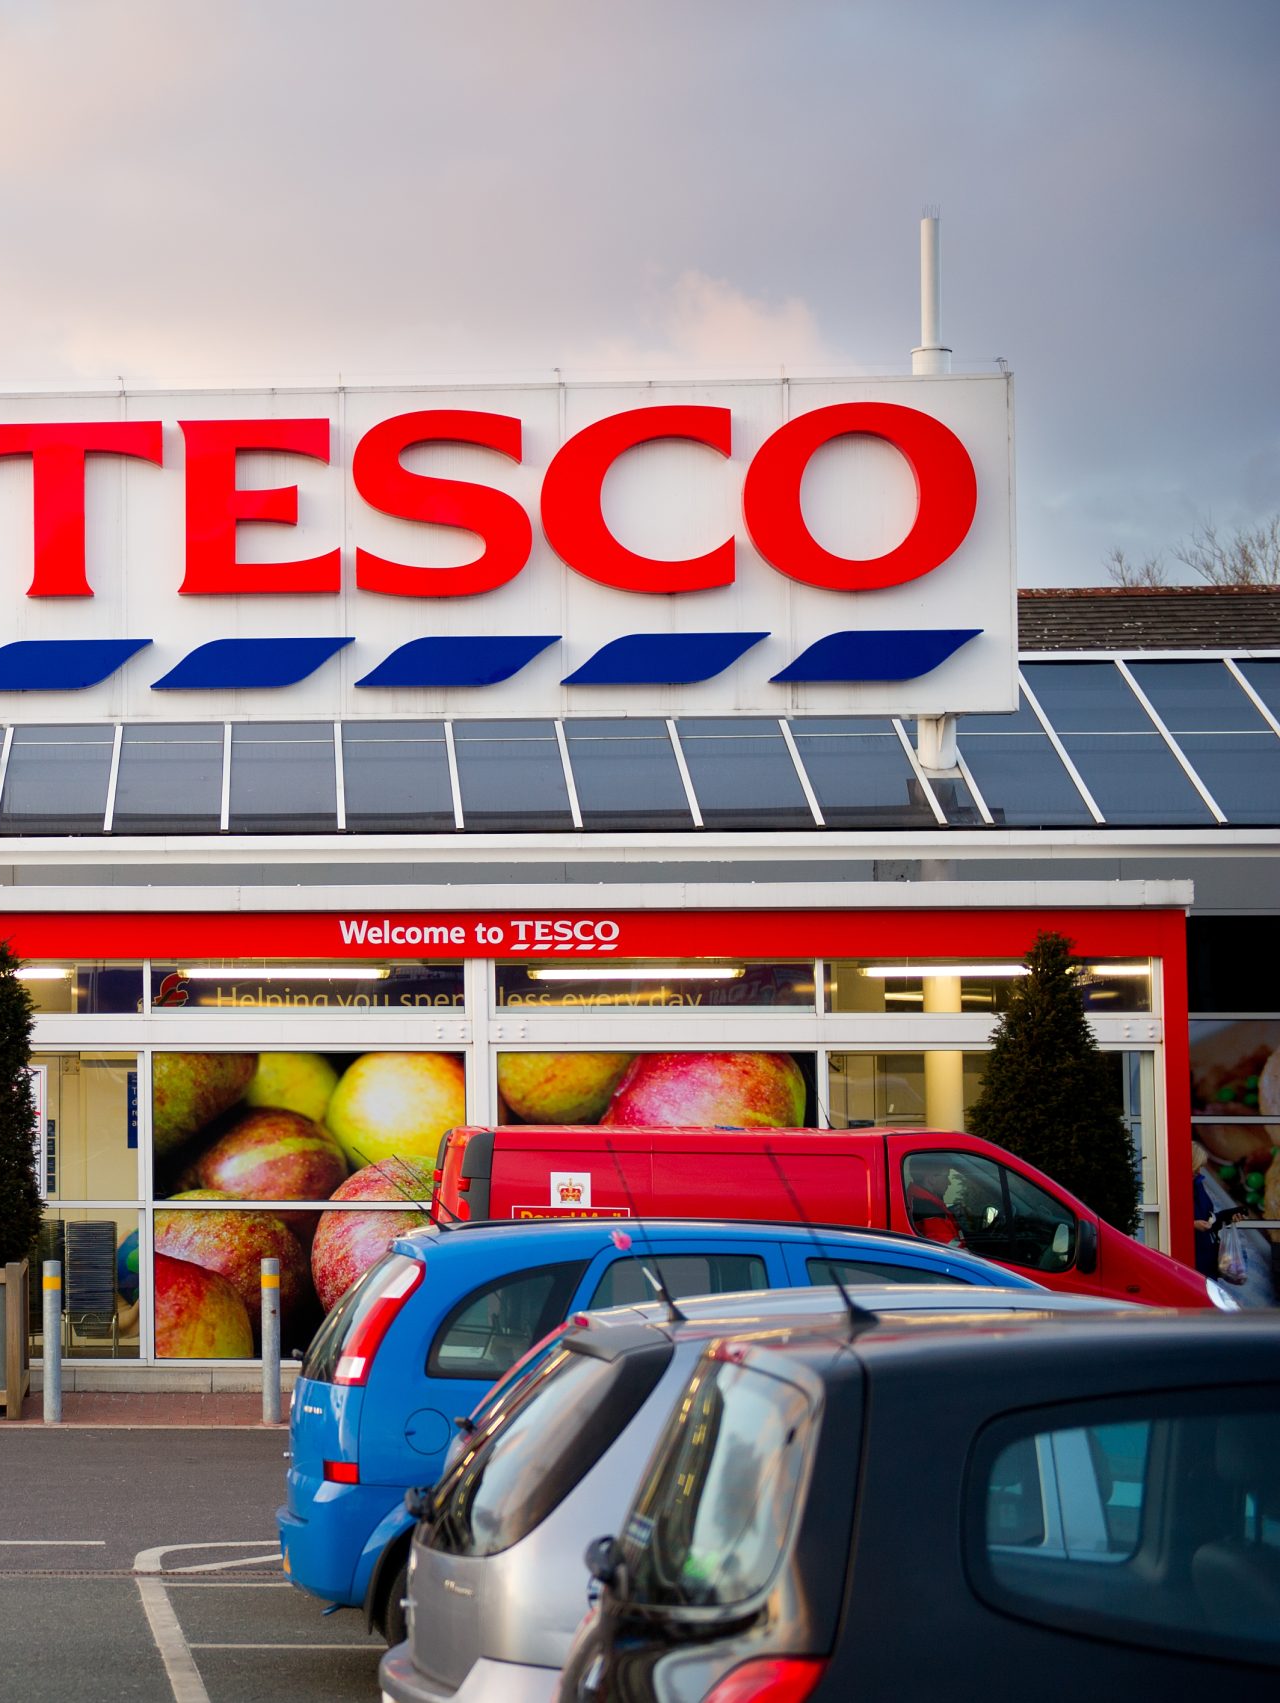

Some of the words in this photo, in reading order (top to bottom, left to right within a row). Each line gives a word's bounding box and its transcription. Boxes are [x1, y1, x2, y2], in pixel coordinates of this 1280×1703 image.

[339, 920, 466, 944] Welcome
[474, 922, 504, 944] to
[510, 920, 620, 941] TESCO
[216, 987, 329, 1006] Helping
[399, 992, 465, 1006] spen
